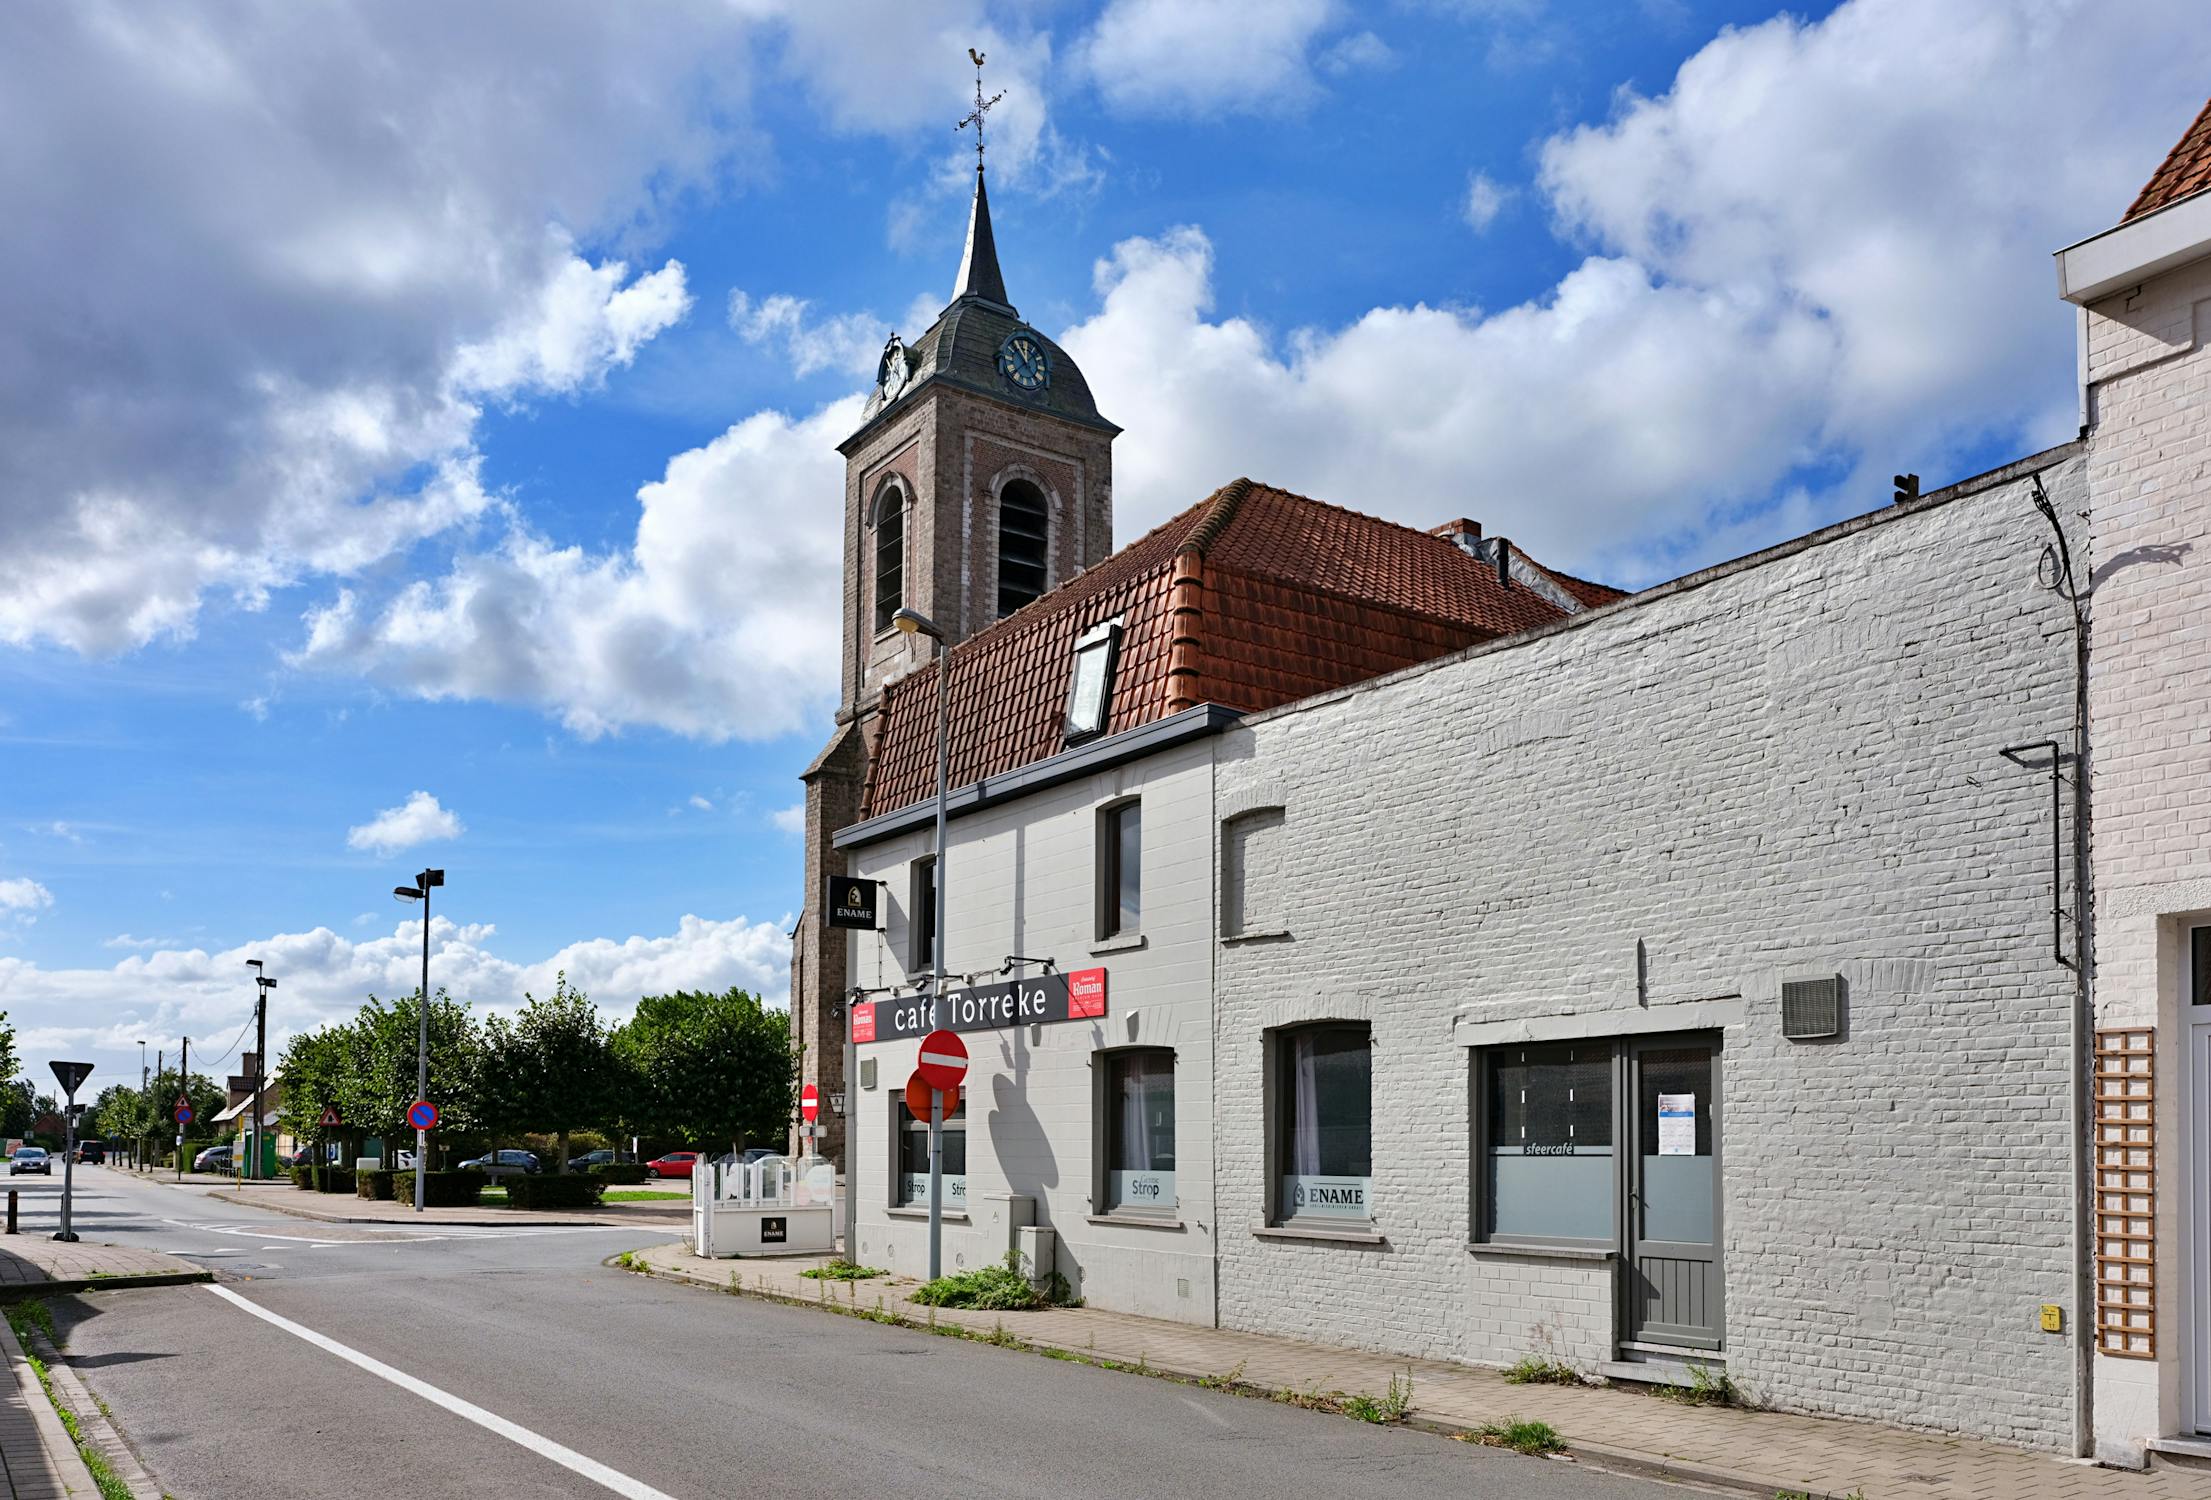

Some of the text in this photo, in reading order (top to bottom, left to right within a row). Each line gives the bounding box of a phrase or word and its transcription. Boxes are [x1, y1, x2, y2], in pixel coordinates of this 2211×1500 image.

[837, 908, 872, 919] ENAME
[1072, 982, 1102, 996] Roman
[947, 984, 1046, 1024] Torreke
[1526, 1142, 1573, 1155] sfeercafé
[907, 1180, 925, 1196] Strop
[952, 1182, 966, 1196] Stro
[1132, 1179, 1159, 1200] Strop
[1310, 1188, 1364, 1205] ENAME
